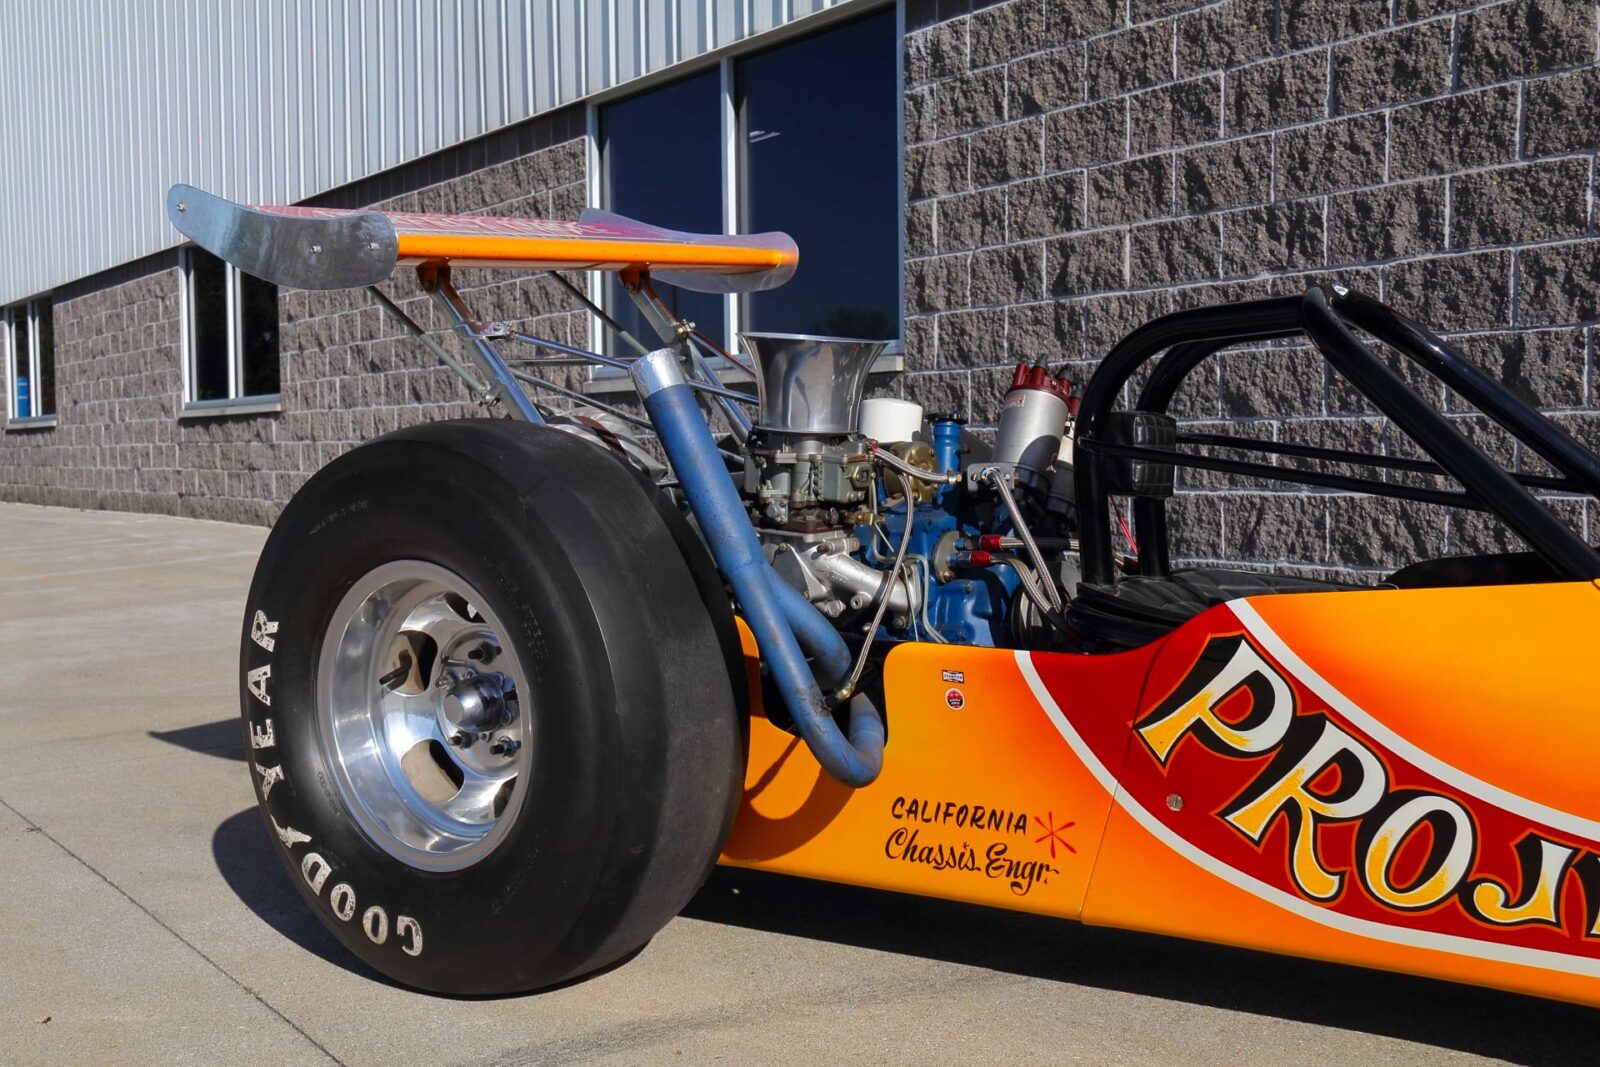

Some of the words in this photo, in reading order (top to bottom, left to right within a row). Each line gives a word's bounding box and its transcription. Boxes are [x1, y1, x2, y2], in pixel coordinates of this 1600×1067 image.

[1133, 632, 1600, 940] PROJ
[891, 796, 1028, 836] CALIFORNIA
[885, 827, 981, 872] Chassis
